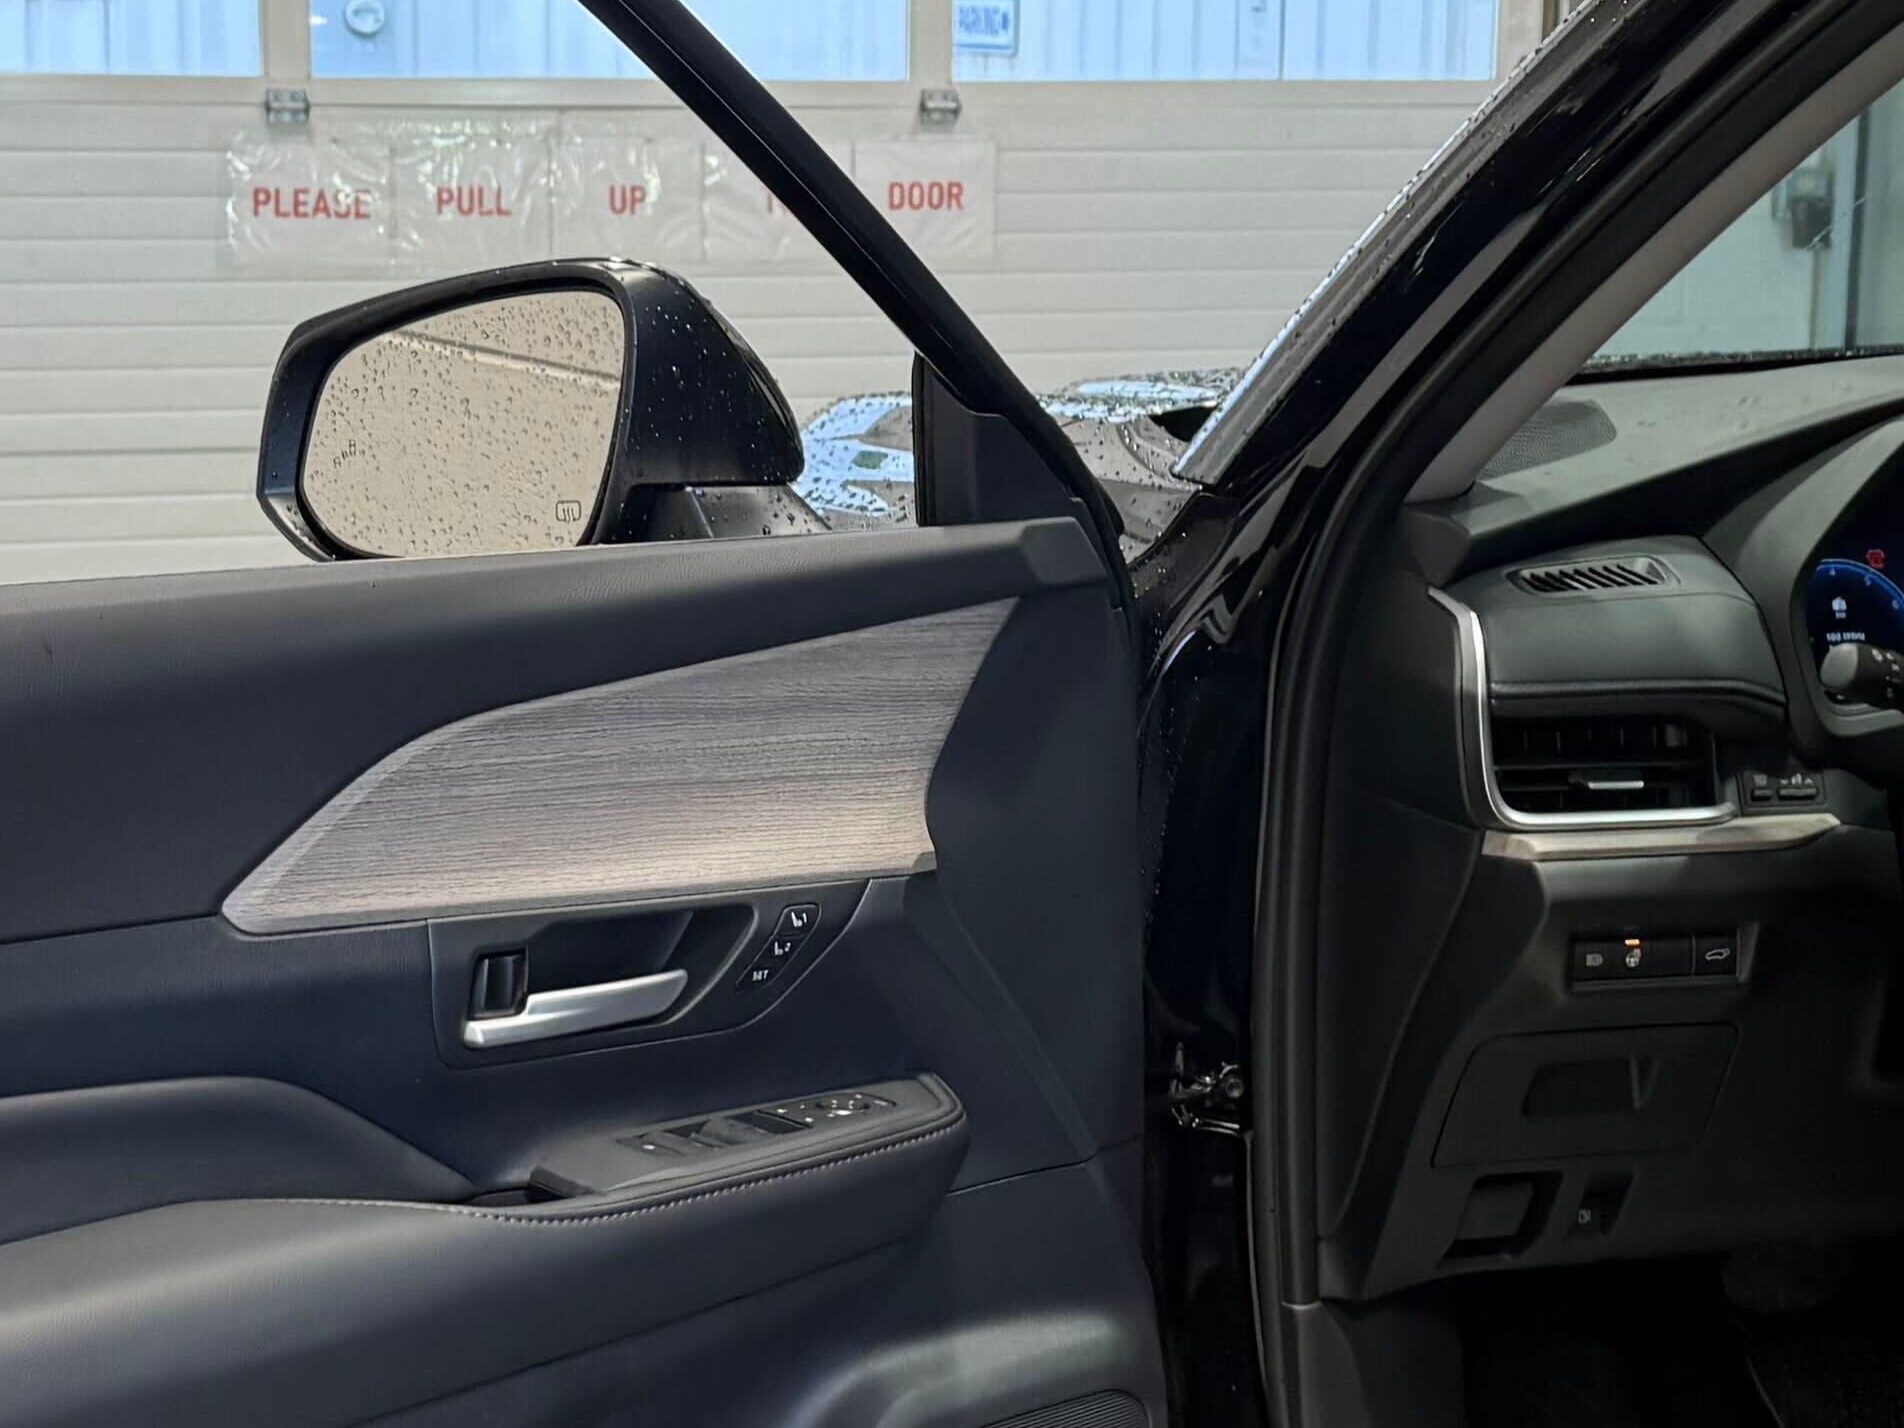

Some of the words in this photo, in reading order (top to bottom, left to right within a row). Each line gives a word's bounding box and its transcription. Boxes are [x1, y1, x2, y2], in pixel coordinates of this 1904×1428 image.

[253, 187, 371, 220] PLEASE
[436, 185, 512, 216] PULL
[609, 184, 646, 216] UP
[888, 181, 964, 211] DOOR
